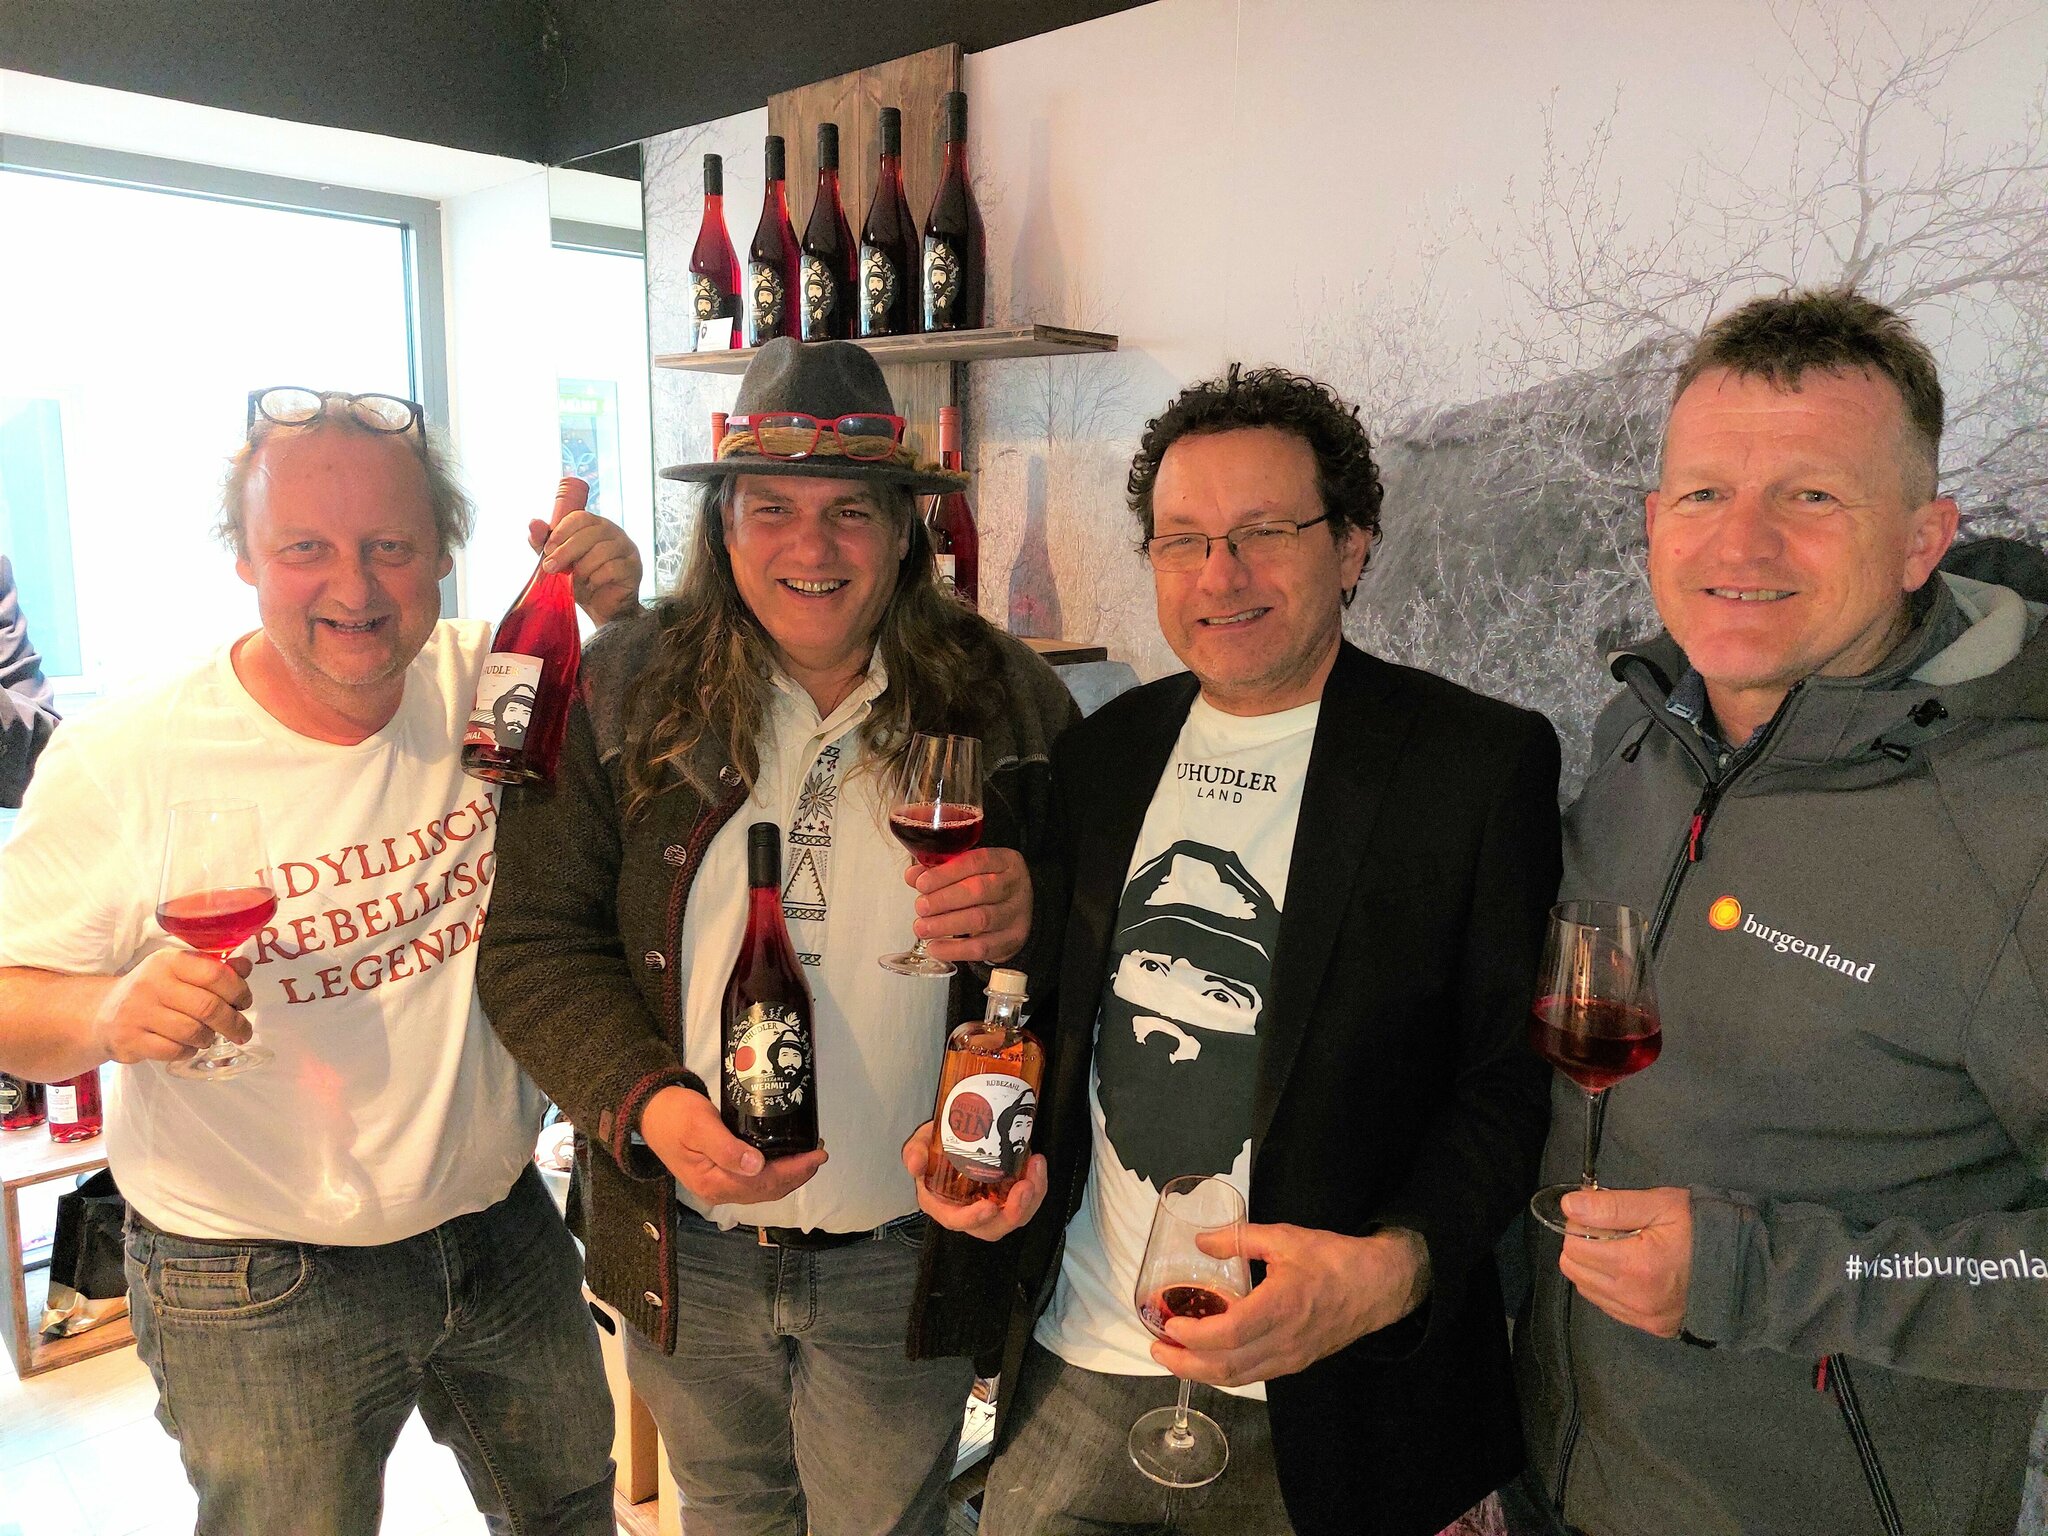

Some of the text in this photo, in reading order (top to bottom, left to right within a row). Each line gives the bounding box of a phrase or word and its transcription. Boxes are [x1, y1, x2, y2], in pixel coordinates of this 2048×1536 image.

[484, 665, 518, 676] UDLER
[1177, 763, 1277, 792] UHUDLER
[1197, 787, 1243, 804] LAND
[1743, 914, 1876, 983] burgenland
[742, 1022, 778, 1045] UHUDLER
[751, 1081, 790, 1091] WERMUT
[949, 1109, 994, 1140] GIN
[1846, 1250, 2048, 1286] #visitburgenla
